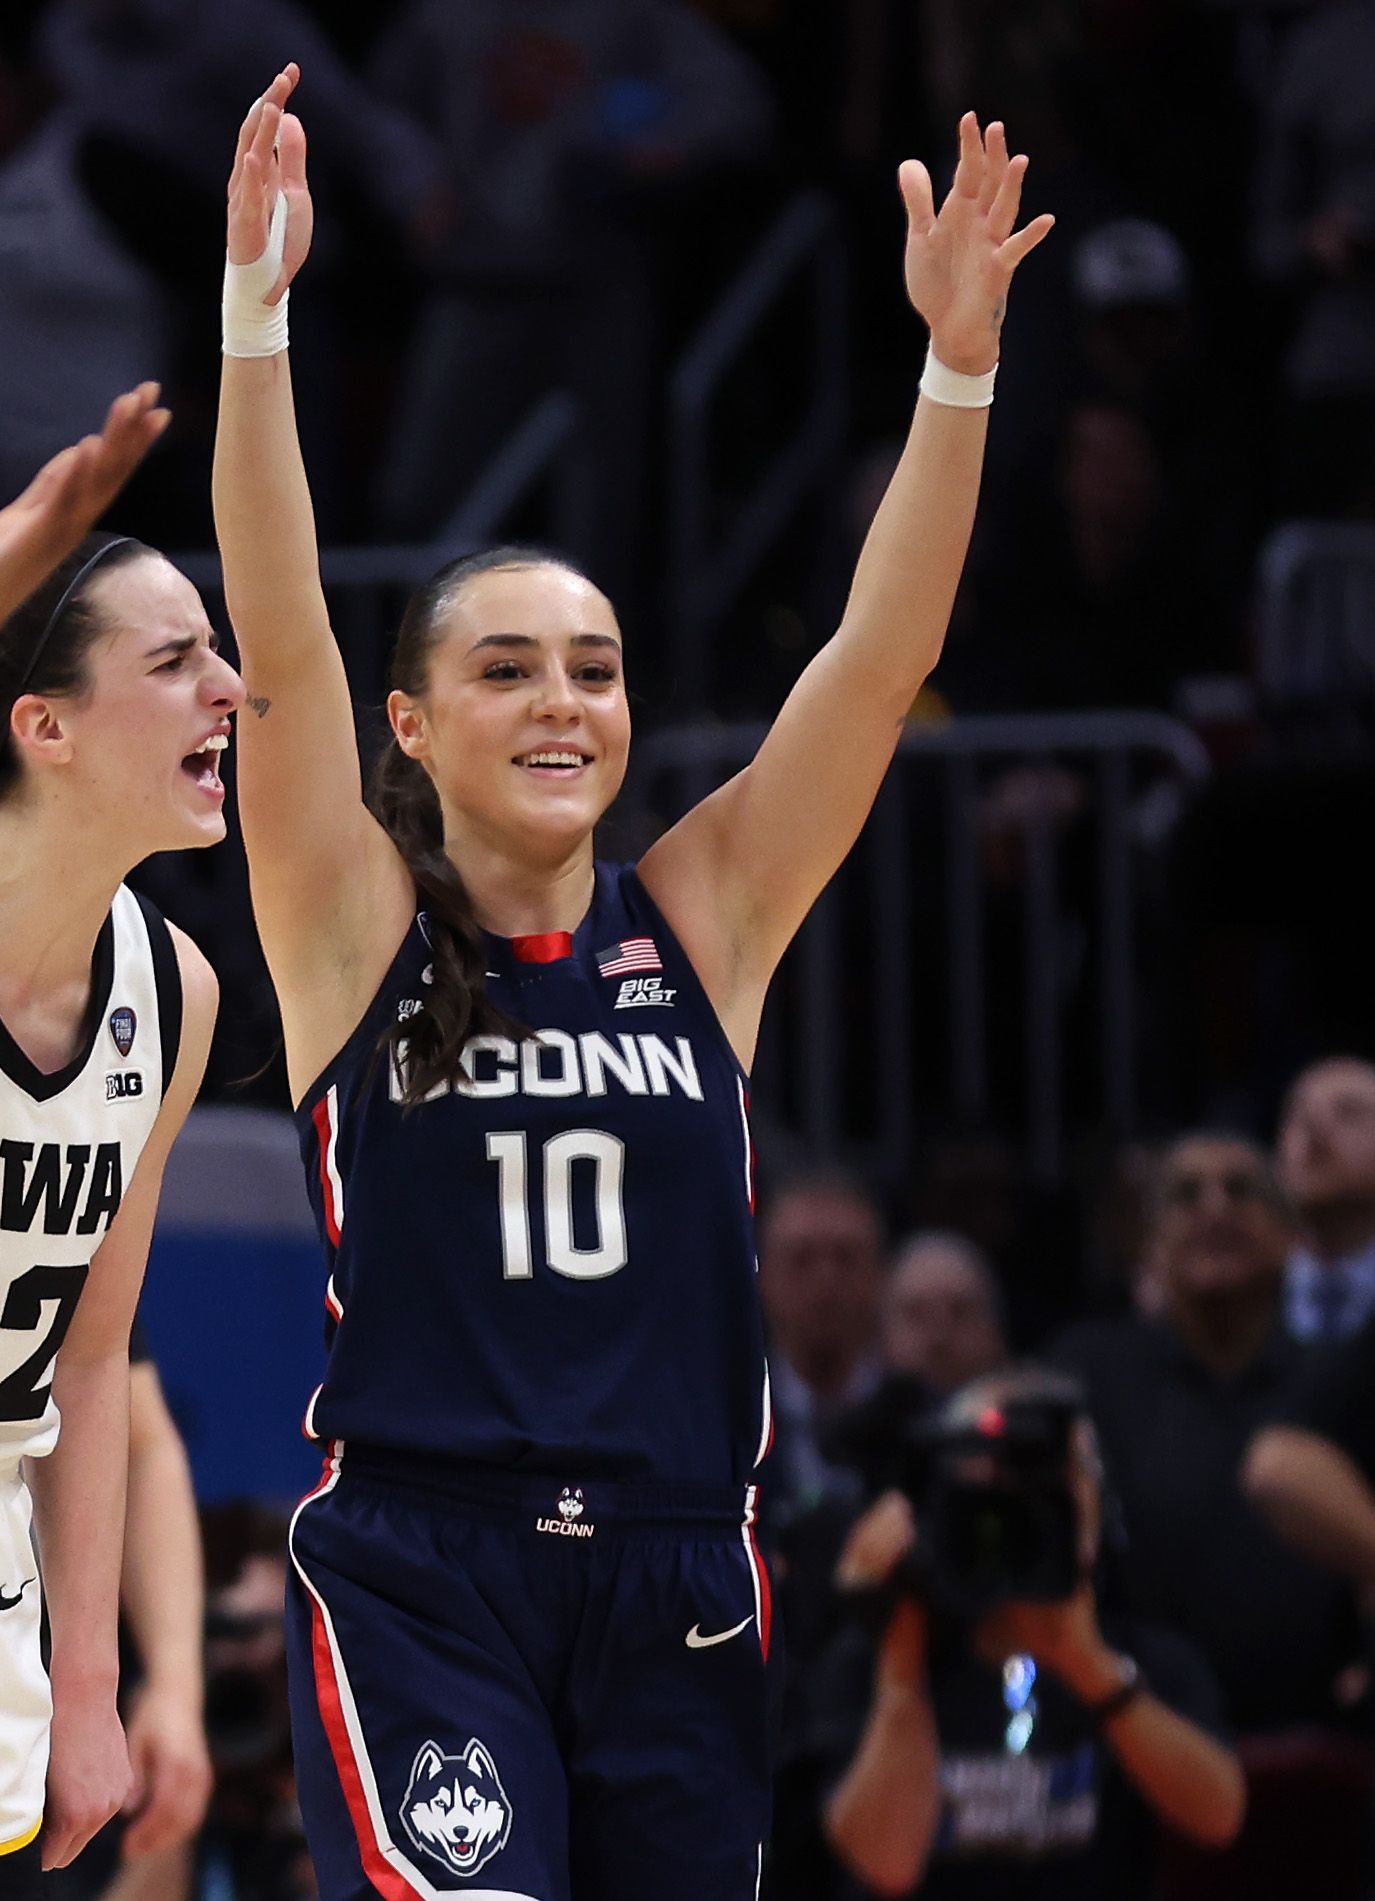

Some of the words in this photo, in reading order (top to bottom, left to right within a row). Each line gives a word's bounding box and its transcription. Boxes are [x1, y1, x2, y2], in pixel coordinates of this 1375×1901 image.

[619, 977, 663, 993] BIG
[615, 989, 678, 1004] EAST
[485, 1128, 628, 1280] 10
[536, 1517, 595, 1538] UCONN
